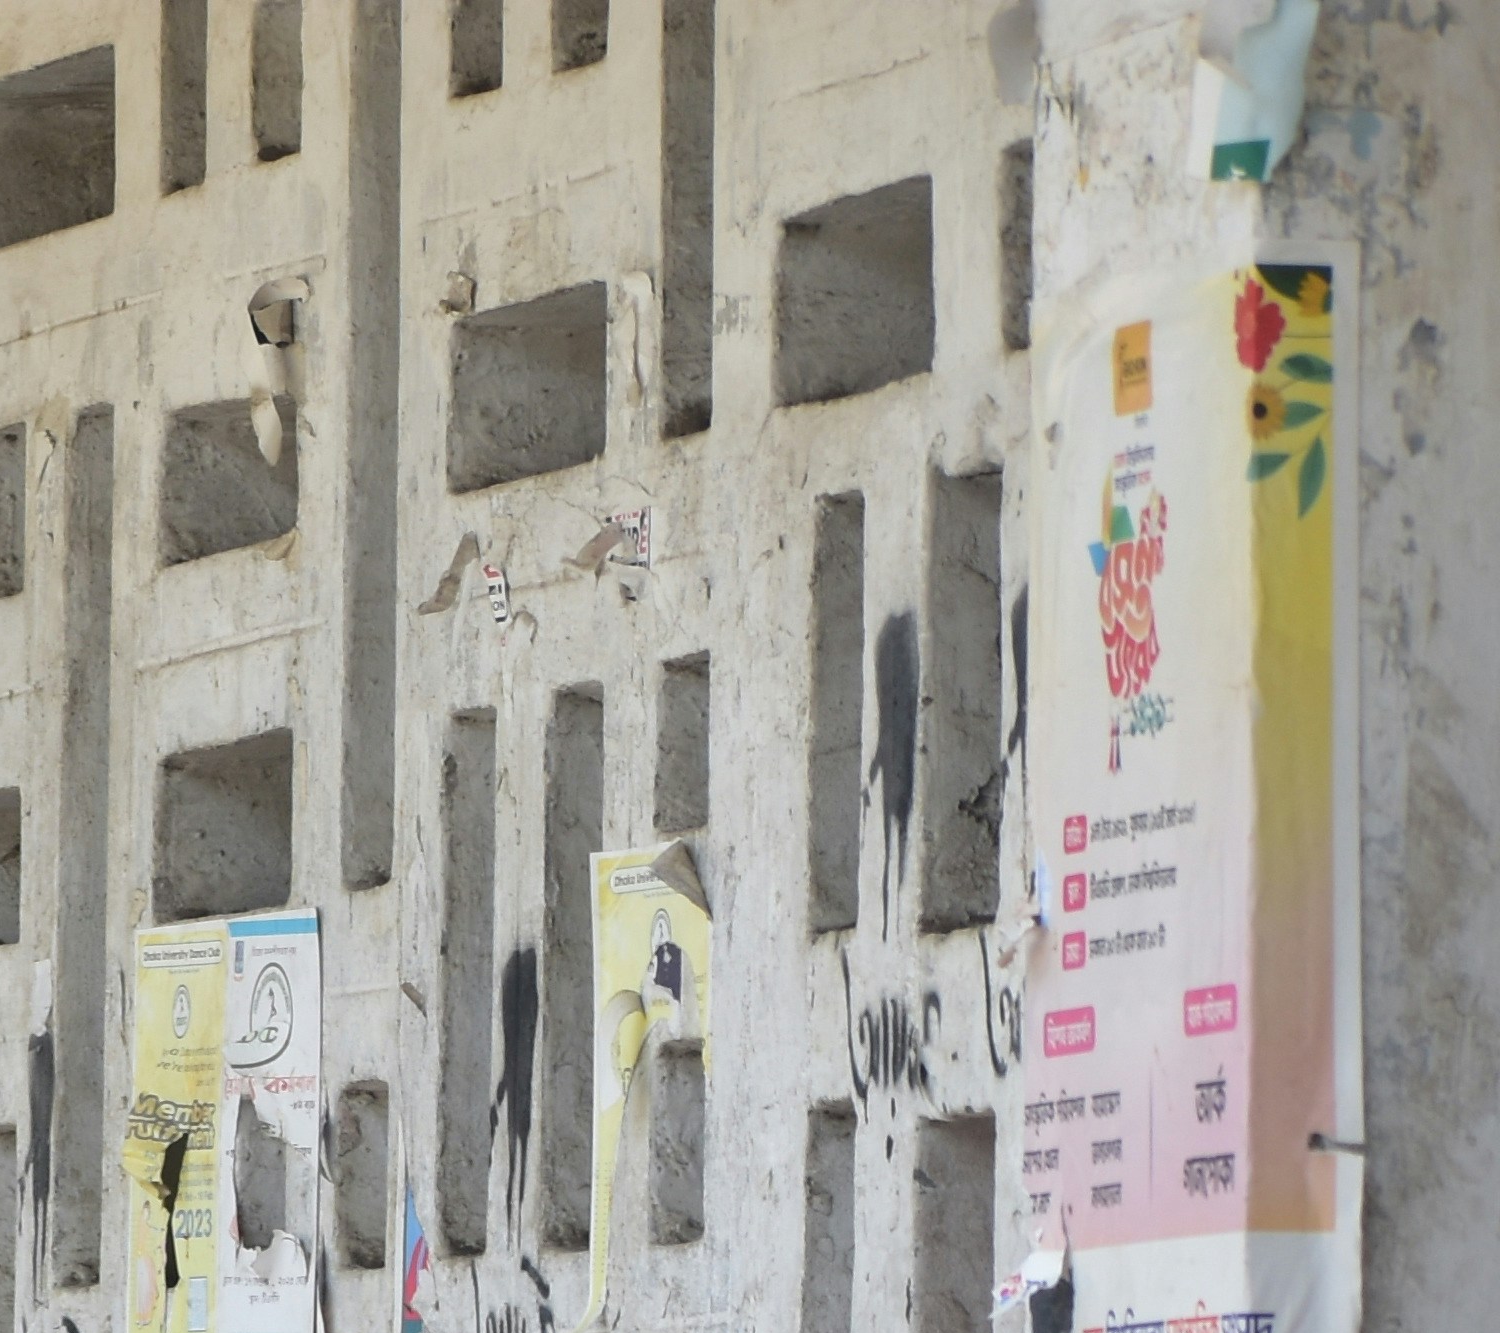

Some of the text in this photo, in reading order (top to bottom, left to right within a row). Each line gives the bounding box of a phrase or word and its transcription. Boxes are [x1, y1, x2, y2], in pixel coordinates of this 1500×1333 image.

[162, 948, 188, 961] University
[189, 947, 207, 960] Dance
[208, 945, 221, 958] Club
[175, 1208, 213, 1239] 2023
